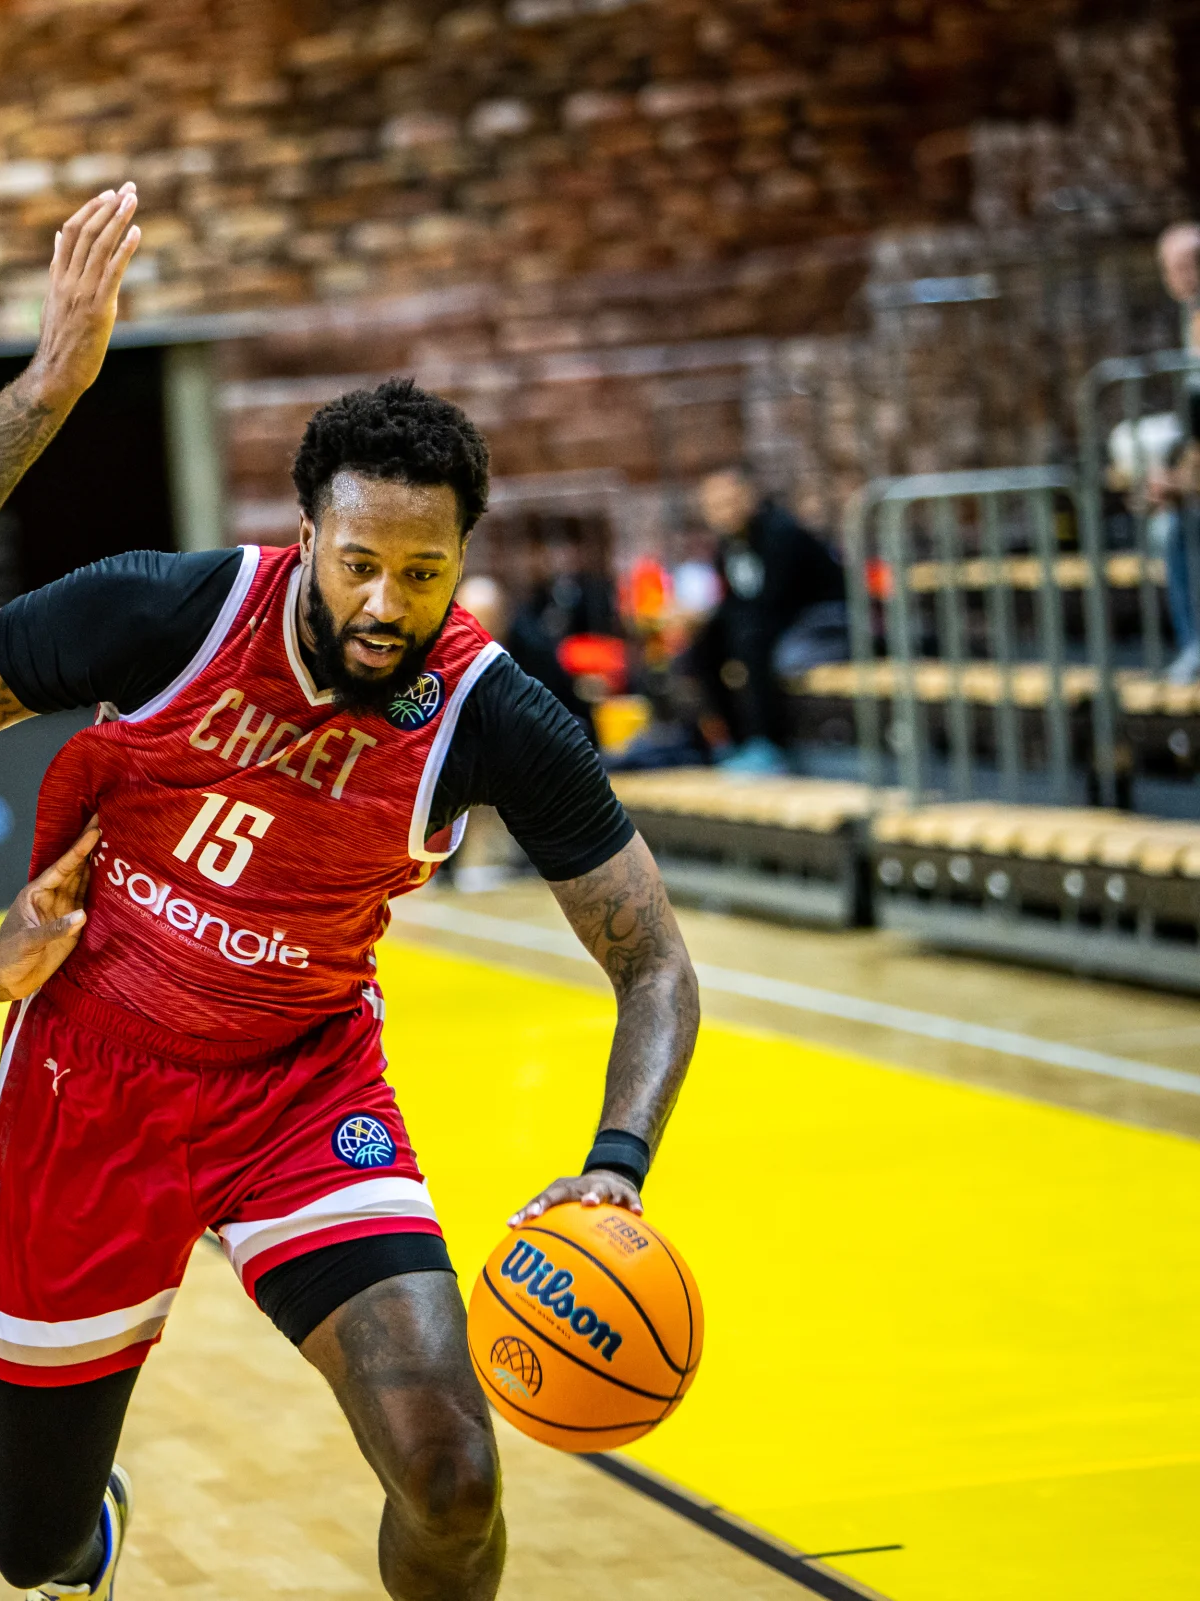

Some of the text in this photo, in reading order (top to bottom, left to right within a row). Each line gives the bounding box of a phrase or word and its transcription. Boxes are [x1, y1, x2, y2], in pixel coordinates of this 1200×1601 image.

[189, 688, 377, 799] CHOLET
[172, 792, 276, 888] 15
[106, 857, 311, 969] solengie
[500, 1238, 623, 1363] Wilson
